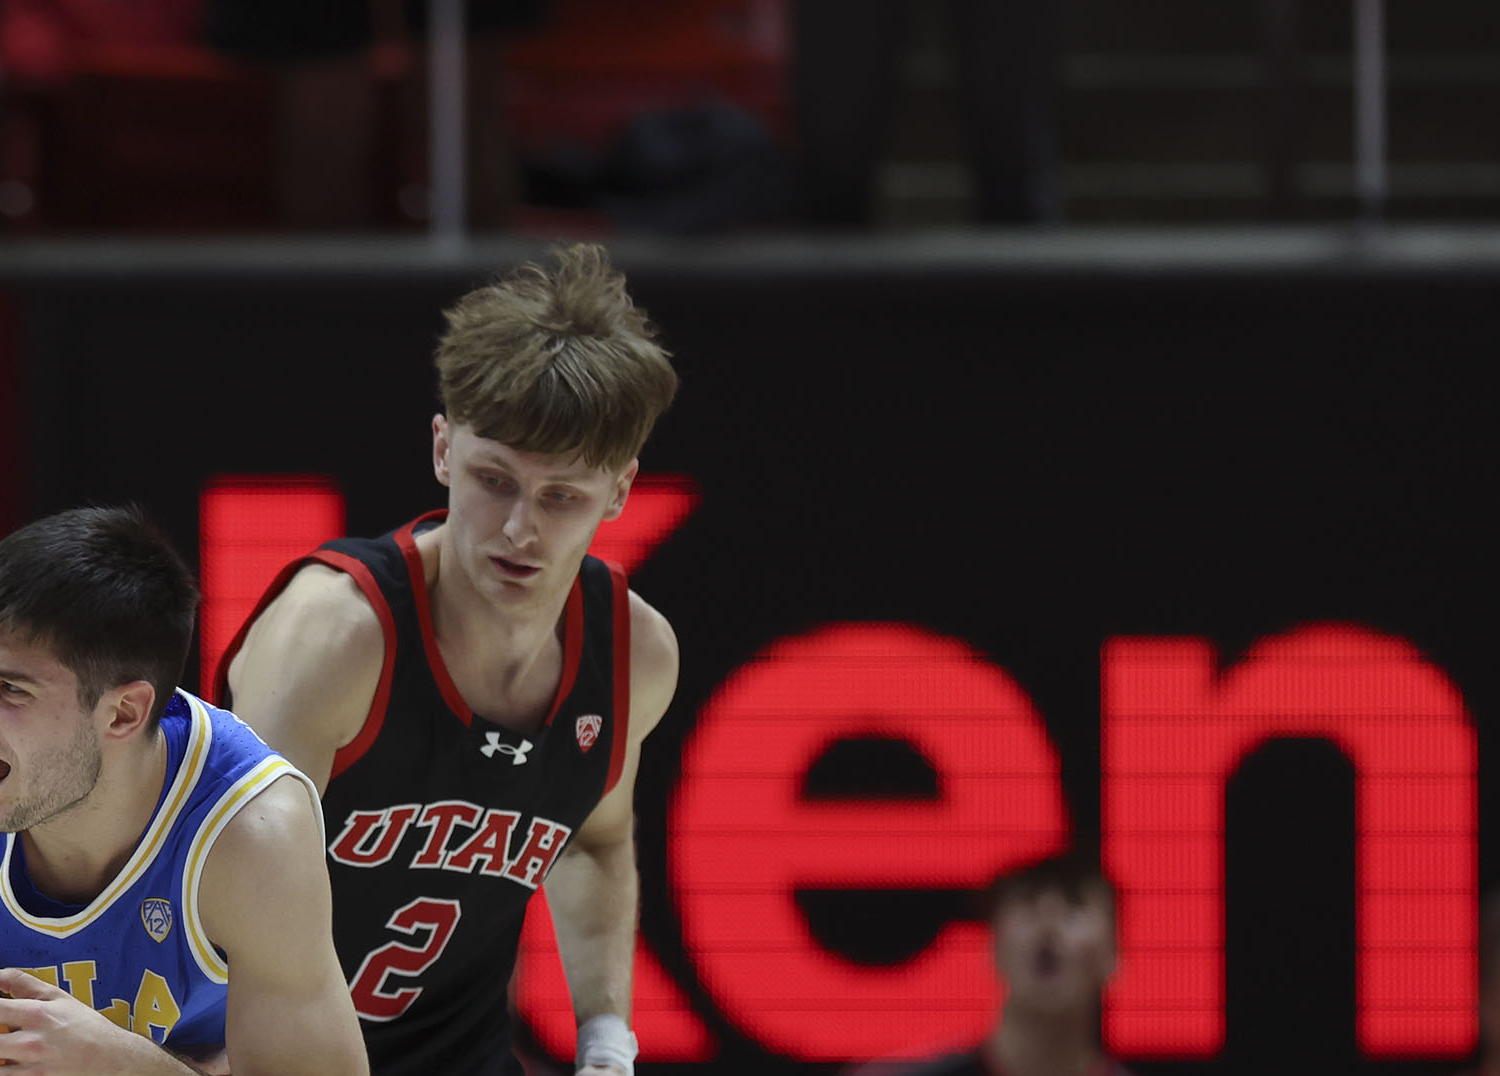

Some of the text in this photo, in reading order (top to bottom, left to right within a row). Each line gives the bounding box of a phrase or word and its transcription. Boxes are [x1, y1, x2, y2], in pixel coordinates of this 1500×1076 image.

[199, 475, 1478, 1062] en
[328, 801, 572, 890] UTAH
[149, 918, 165, 934] 12
[348, 896, 462, 1022] 2
